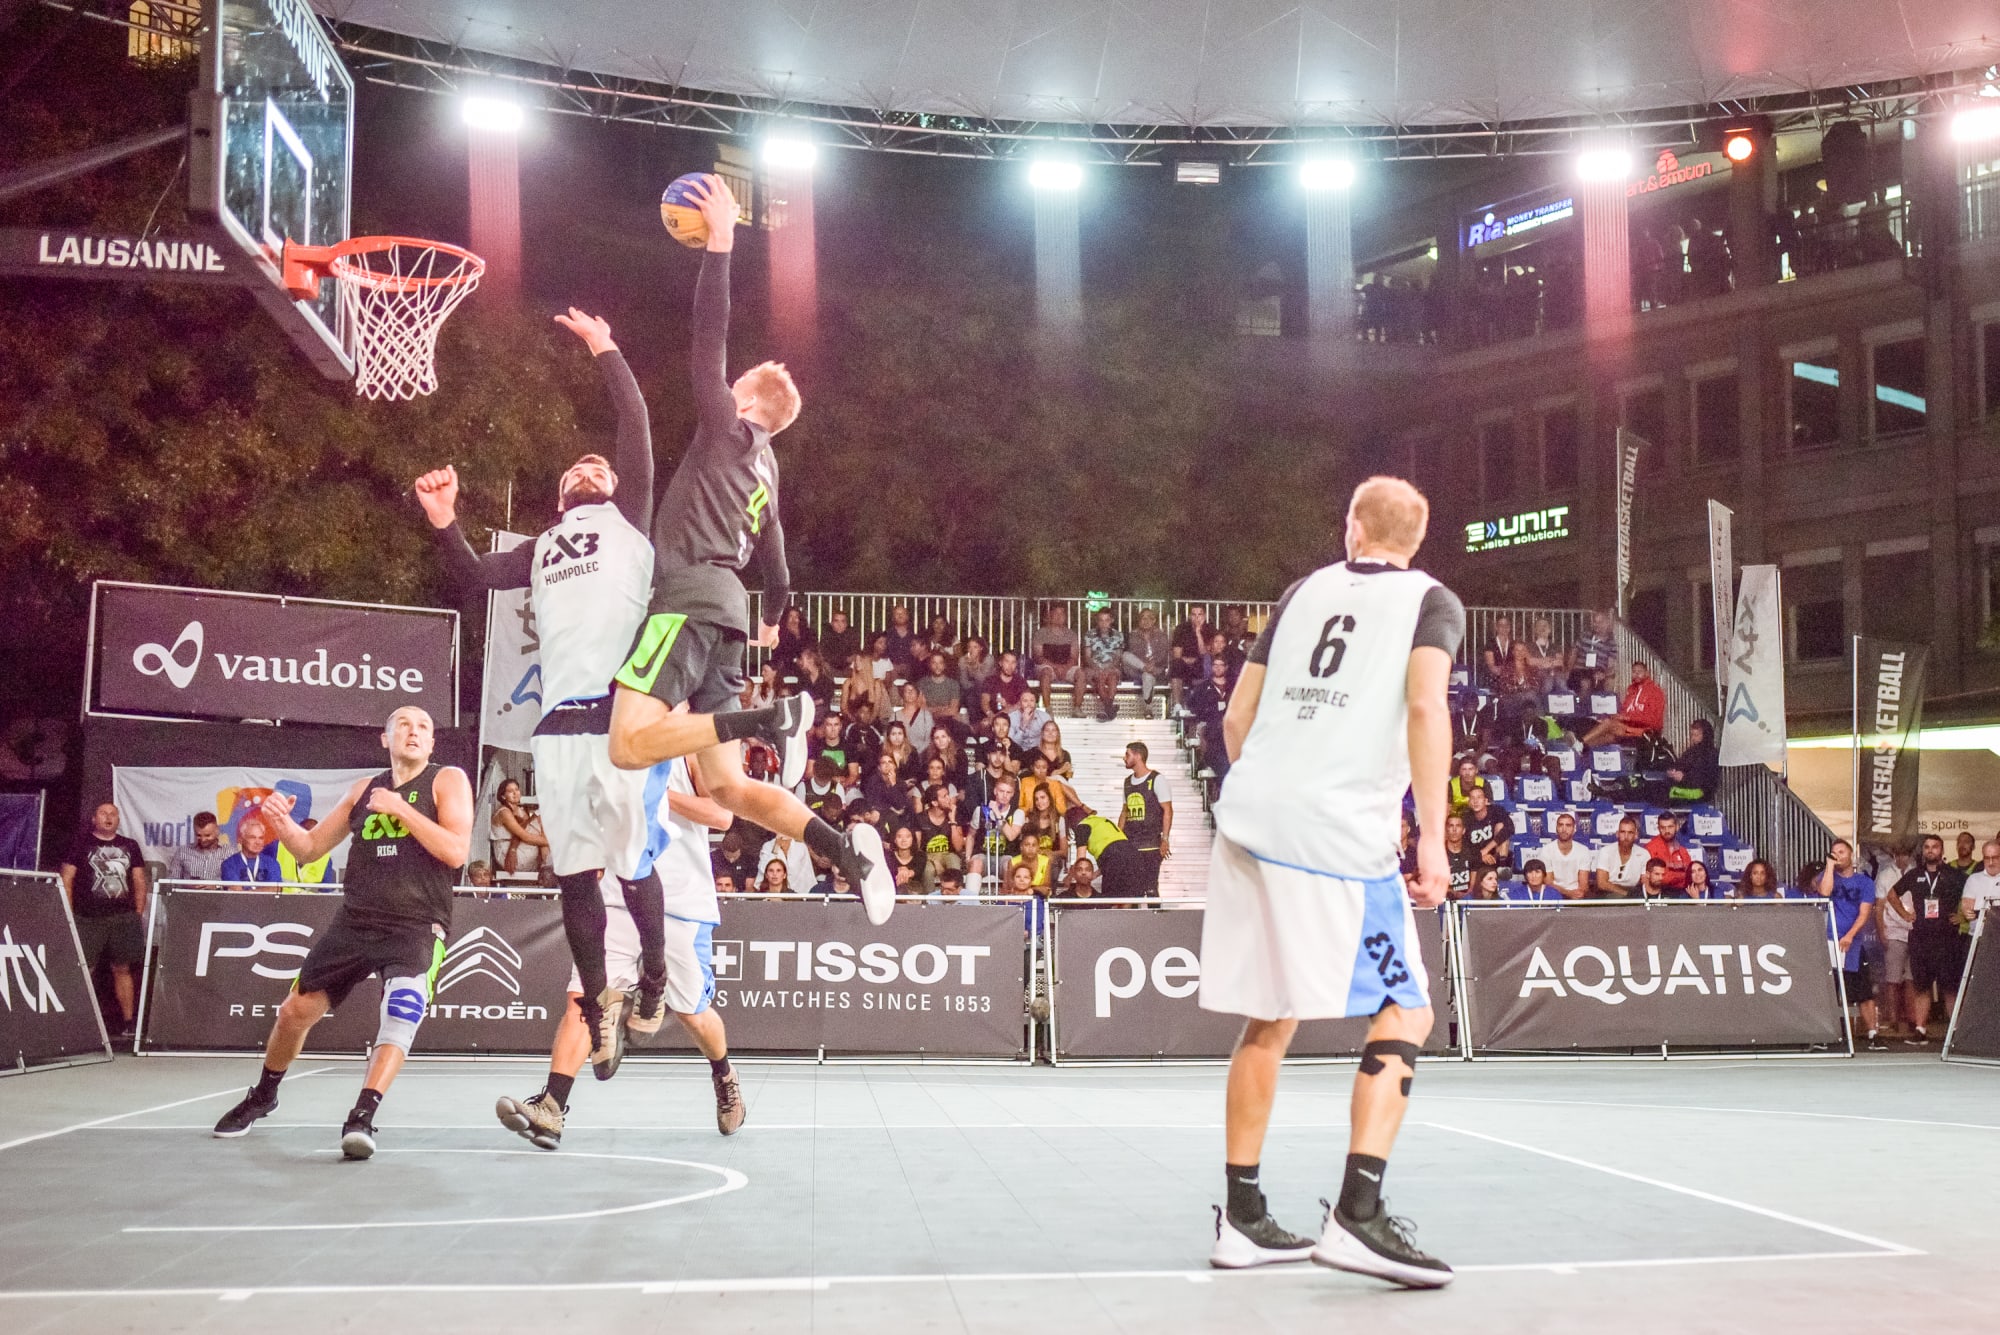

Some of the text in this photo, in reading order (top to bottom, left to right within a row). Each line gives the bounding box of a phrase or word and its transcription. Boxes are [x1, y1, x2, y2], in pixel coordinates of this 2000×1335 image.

[268, 0, 330, 104] USANNE
[1506, 211, 1534, 226] MONEY
[1534, 198, 1573, 216] TRANSFER
[1468, 212, 1505, 247] Ria
[39, 235, 225, 271] LAUSANNE
[1513, 528, 1569, 545] solutions
[544, 561, 600, 586] HUMPOLEC
[515, 586, 541, 656] vt
[1309, 615, 1357, 679] 6
[214, 648, 424, 693] vaudoise
[1282, 686, 1350, 708] HUMPOLEC
[1297, 705, 1319, 721] CZE
[1871, 652, 1906, 834] NIKEBASKETBALL
[408, 791, 418, 803] 6
[143, 815, 195, 848] worl
[1931, 819, 1969, 832] sports
[377, 845, 398, 857] RIGA
[750, 941, 991, 985] TISSOT
[1519, 943, 1793, 1005] AQUATIS
[1094, 946, 1201, 1018] pe
[229, 1004, 334, 1018] RET
[422, 1001, 548, 1020] ITROËN
[740, 990, 851, 1010] WATCHES
[862, 992, 932, 1012] SINCE
[943, 995, 991, 1013] 1853
